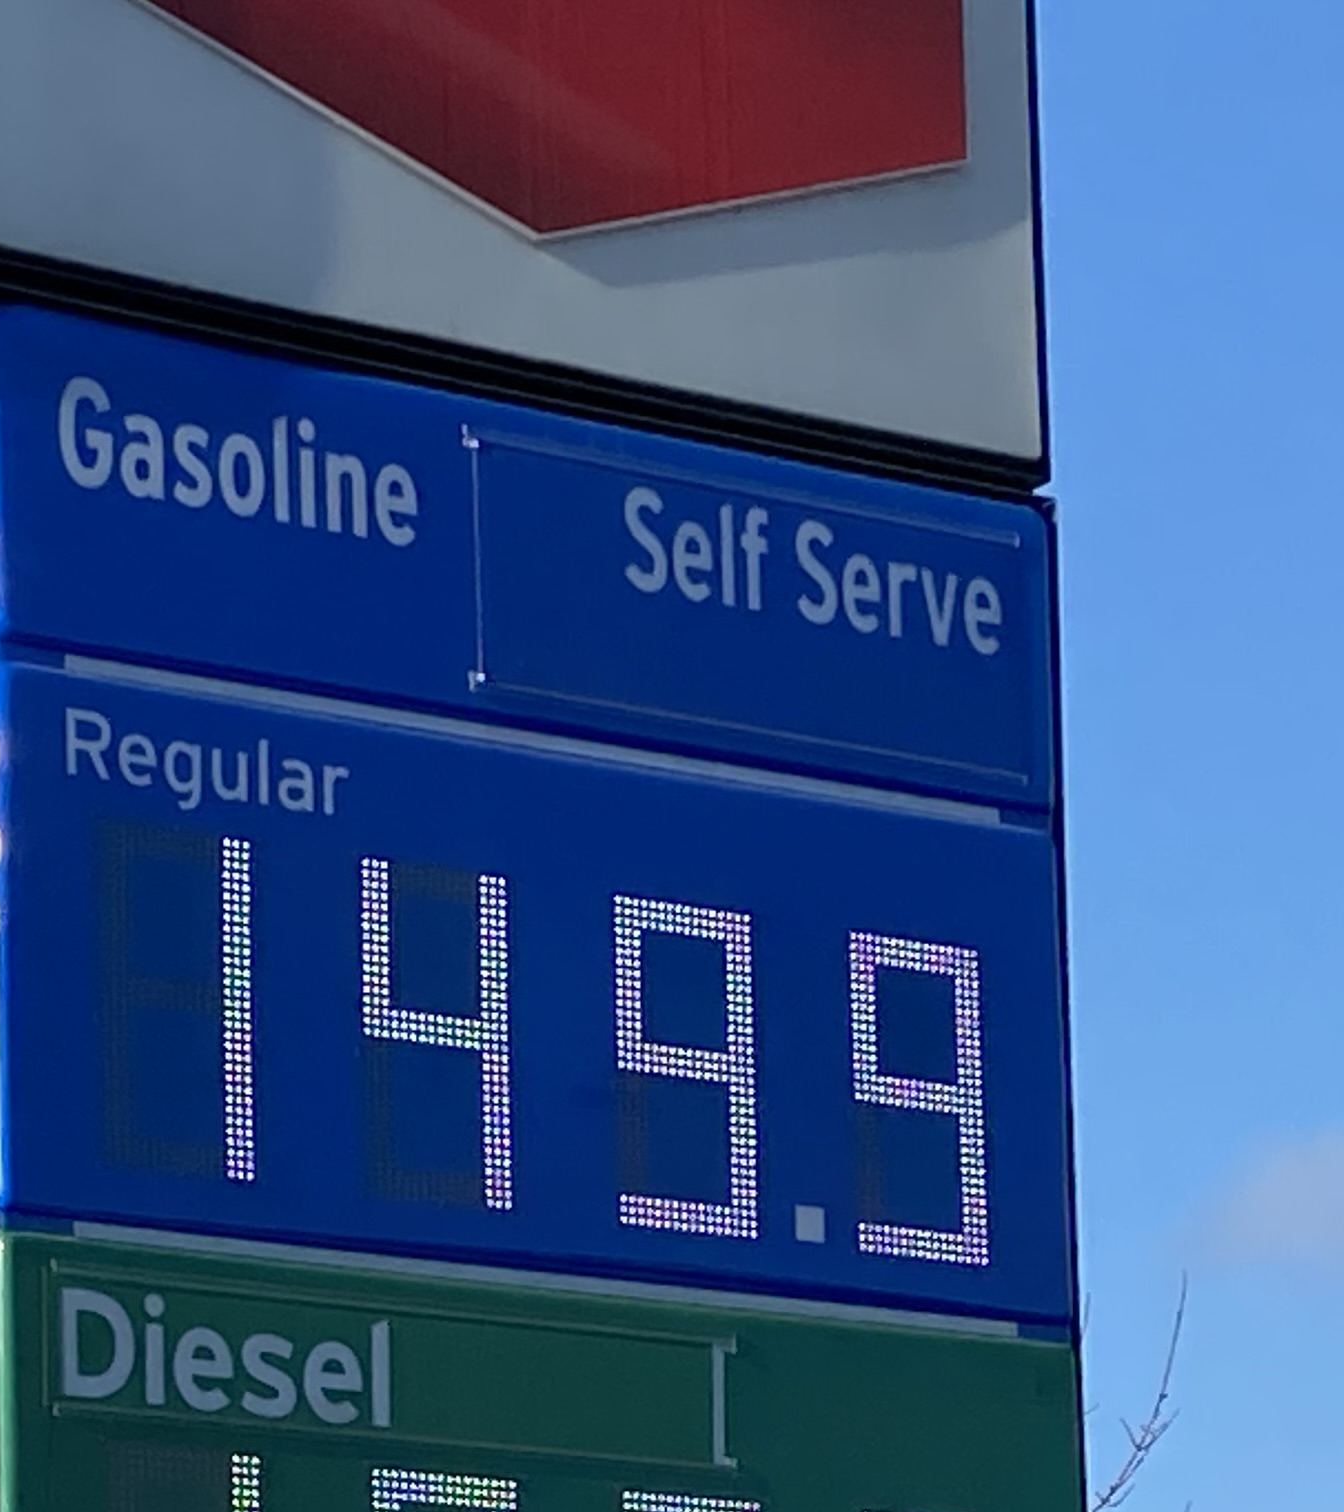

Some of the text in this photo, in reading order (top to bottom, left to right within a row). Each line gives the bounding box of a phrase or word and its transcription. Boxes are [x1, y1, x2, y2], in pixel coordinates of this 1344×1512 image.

[57, 375, 419, 548] Gasoline
[624, 486, 1004, 657] Self Serve
[64, 706, 350, 817] Regular
[220, 836, 991, 1267] 149.9
[59, 1287, 392, 1428] Diesel
